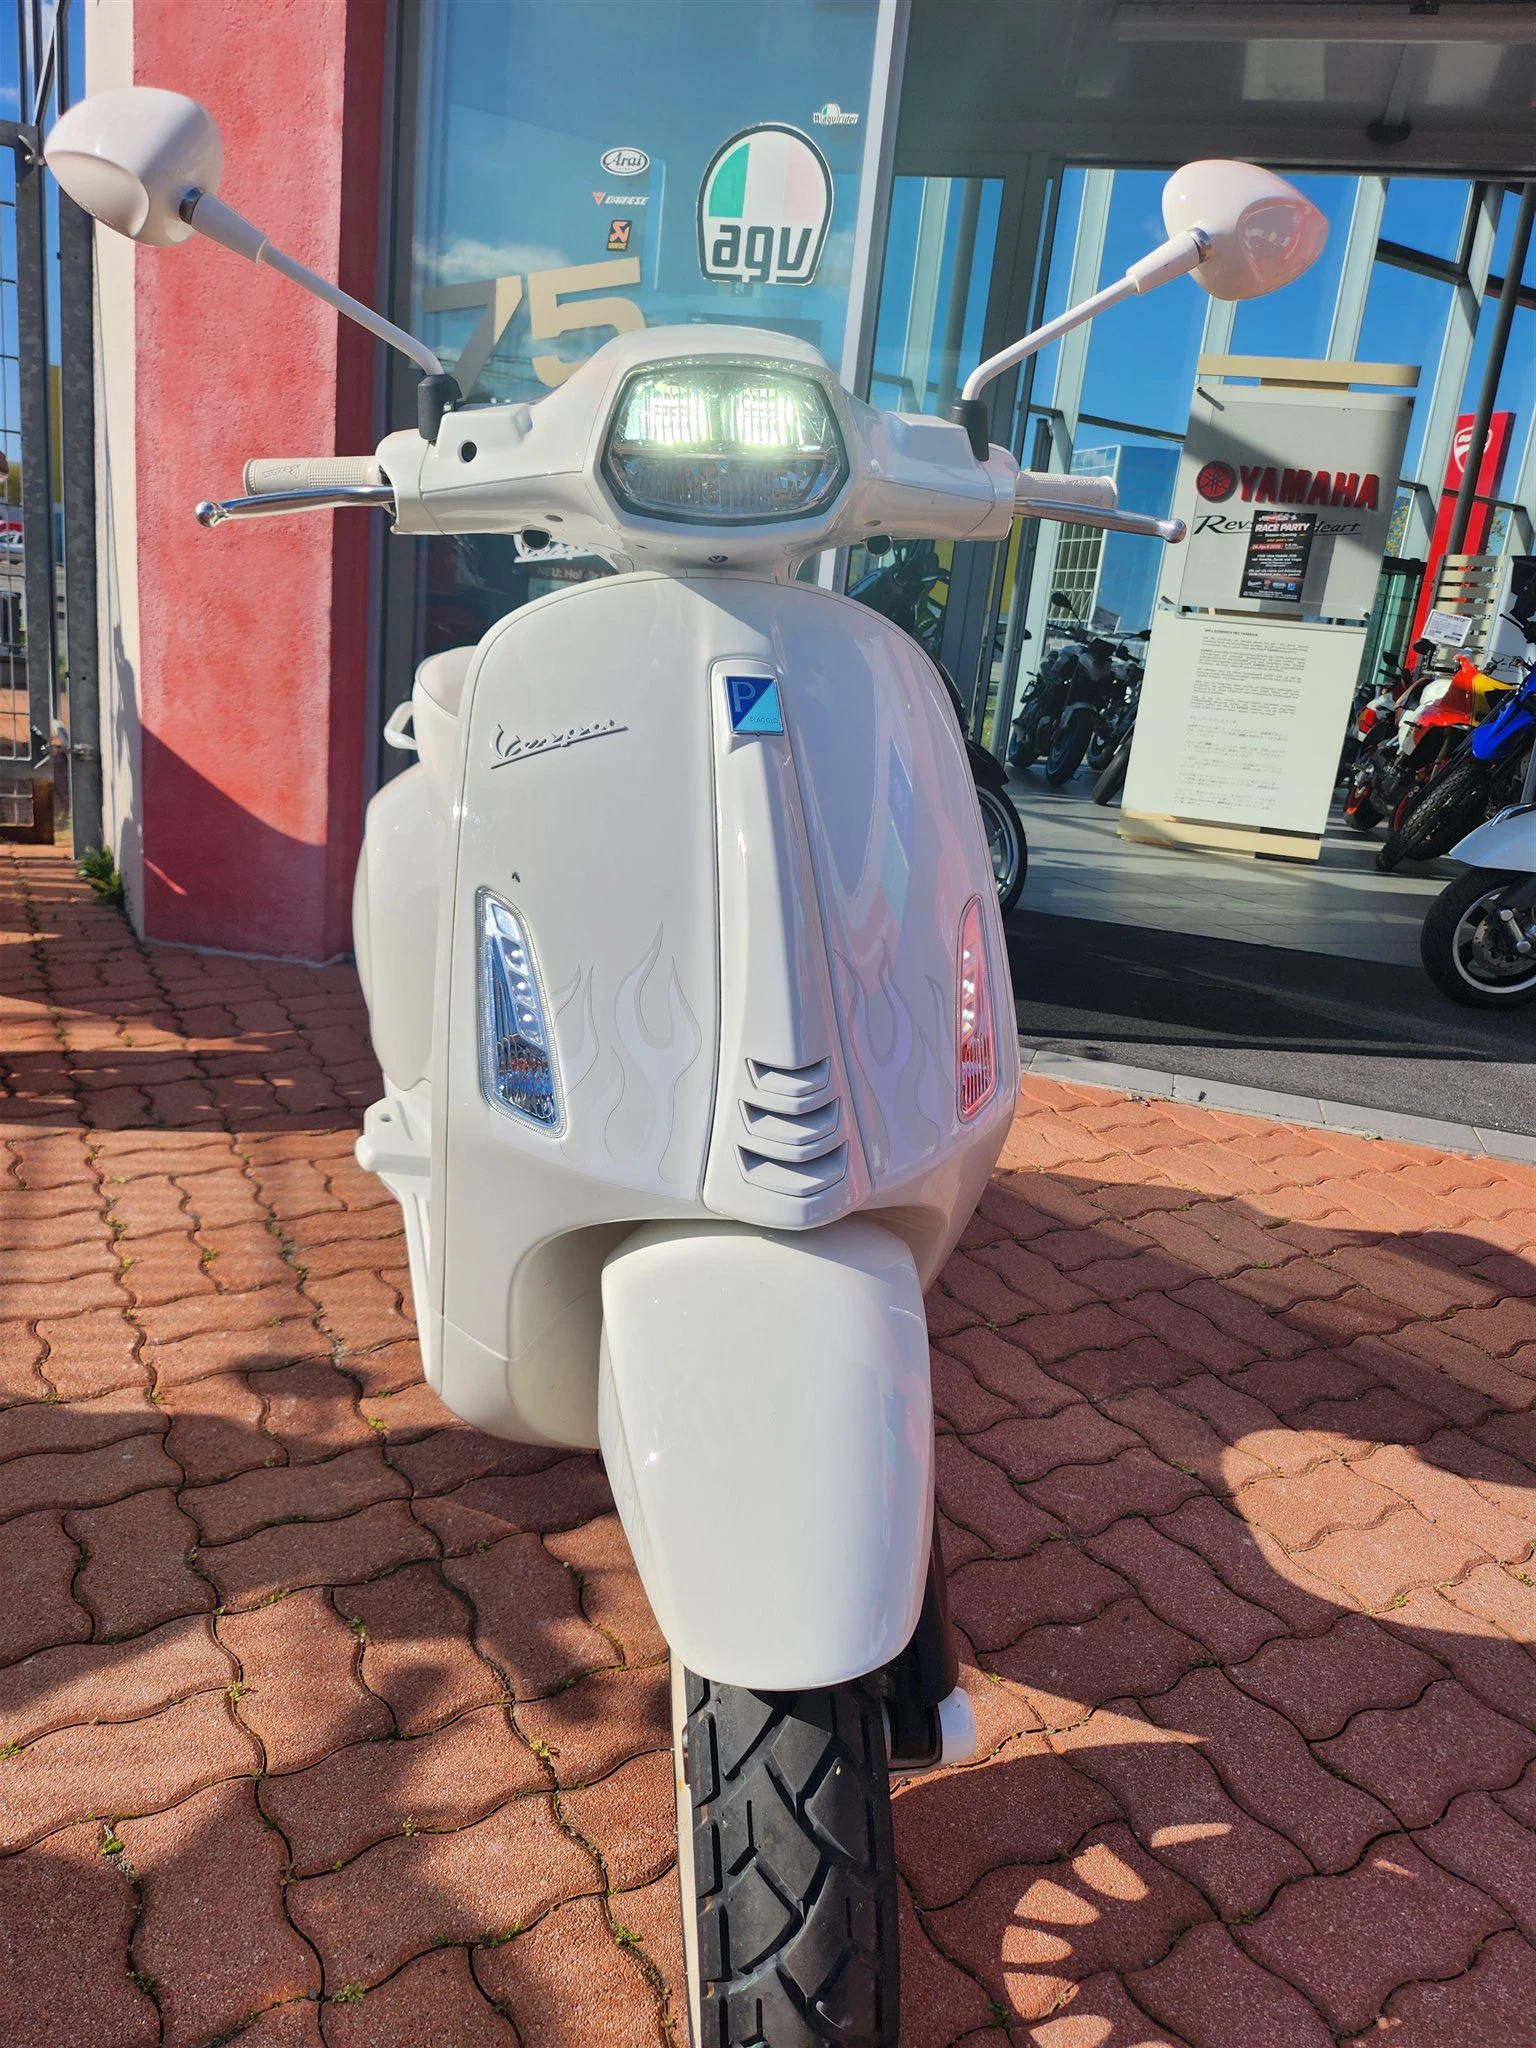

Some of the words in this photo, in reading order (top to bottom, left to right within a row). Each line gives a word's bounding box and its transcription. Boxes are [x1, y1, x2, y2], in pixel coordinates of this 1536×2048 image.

[606, 152, 643, 167] Arai
[712, 224, 813, 282] agv
[422, 257, 646, 400] 75
[1239, 465, 1379, 510] YAMAHA
[1194, 515, 1251, 535] Rev
[1255, 523, 1279, 532] RACE
[1280, 522, 1311, 532] PARTY
[731, 681, 756, 713] P
[489, 720, 627, 767] Vespa
